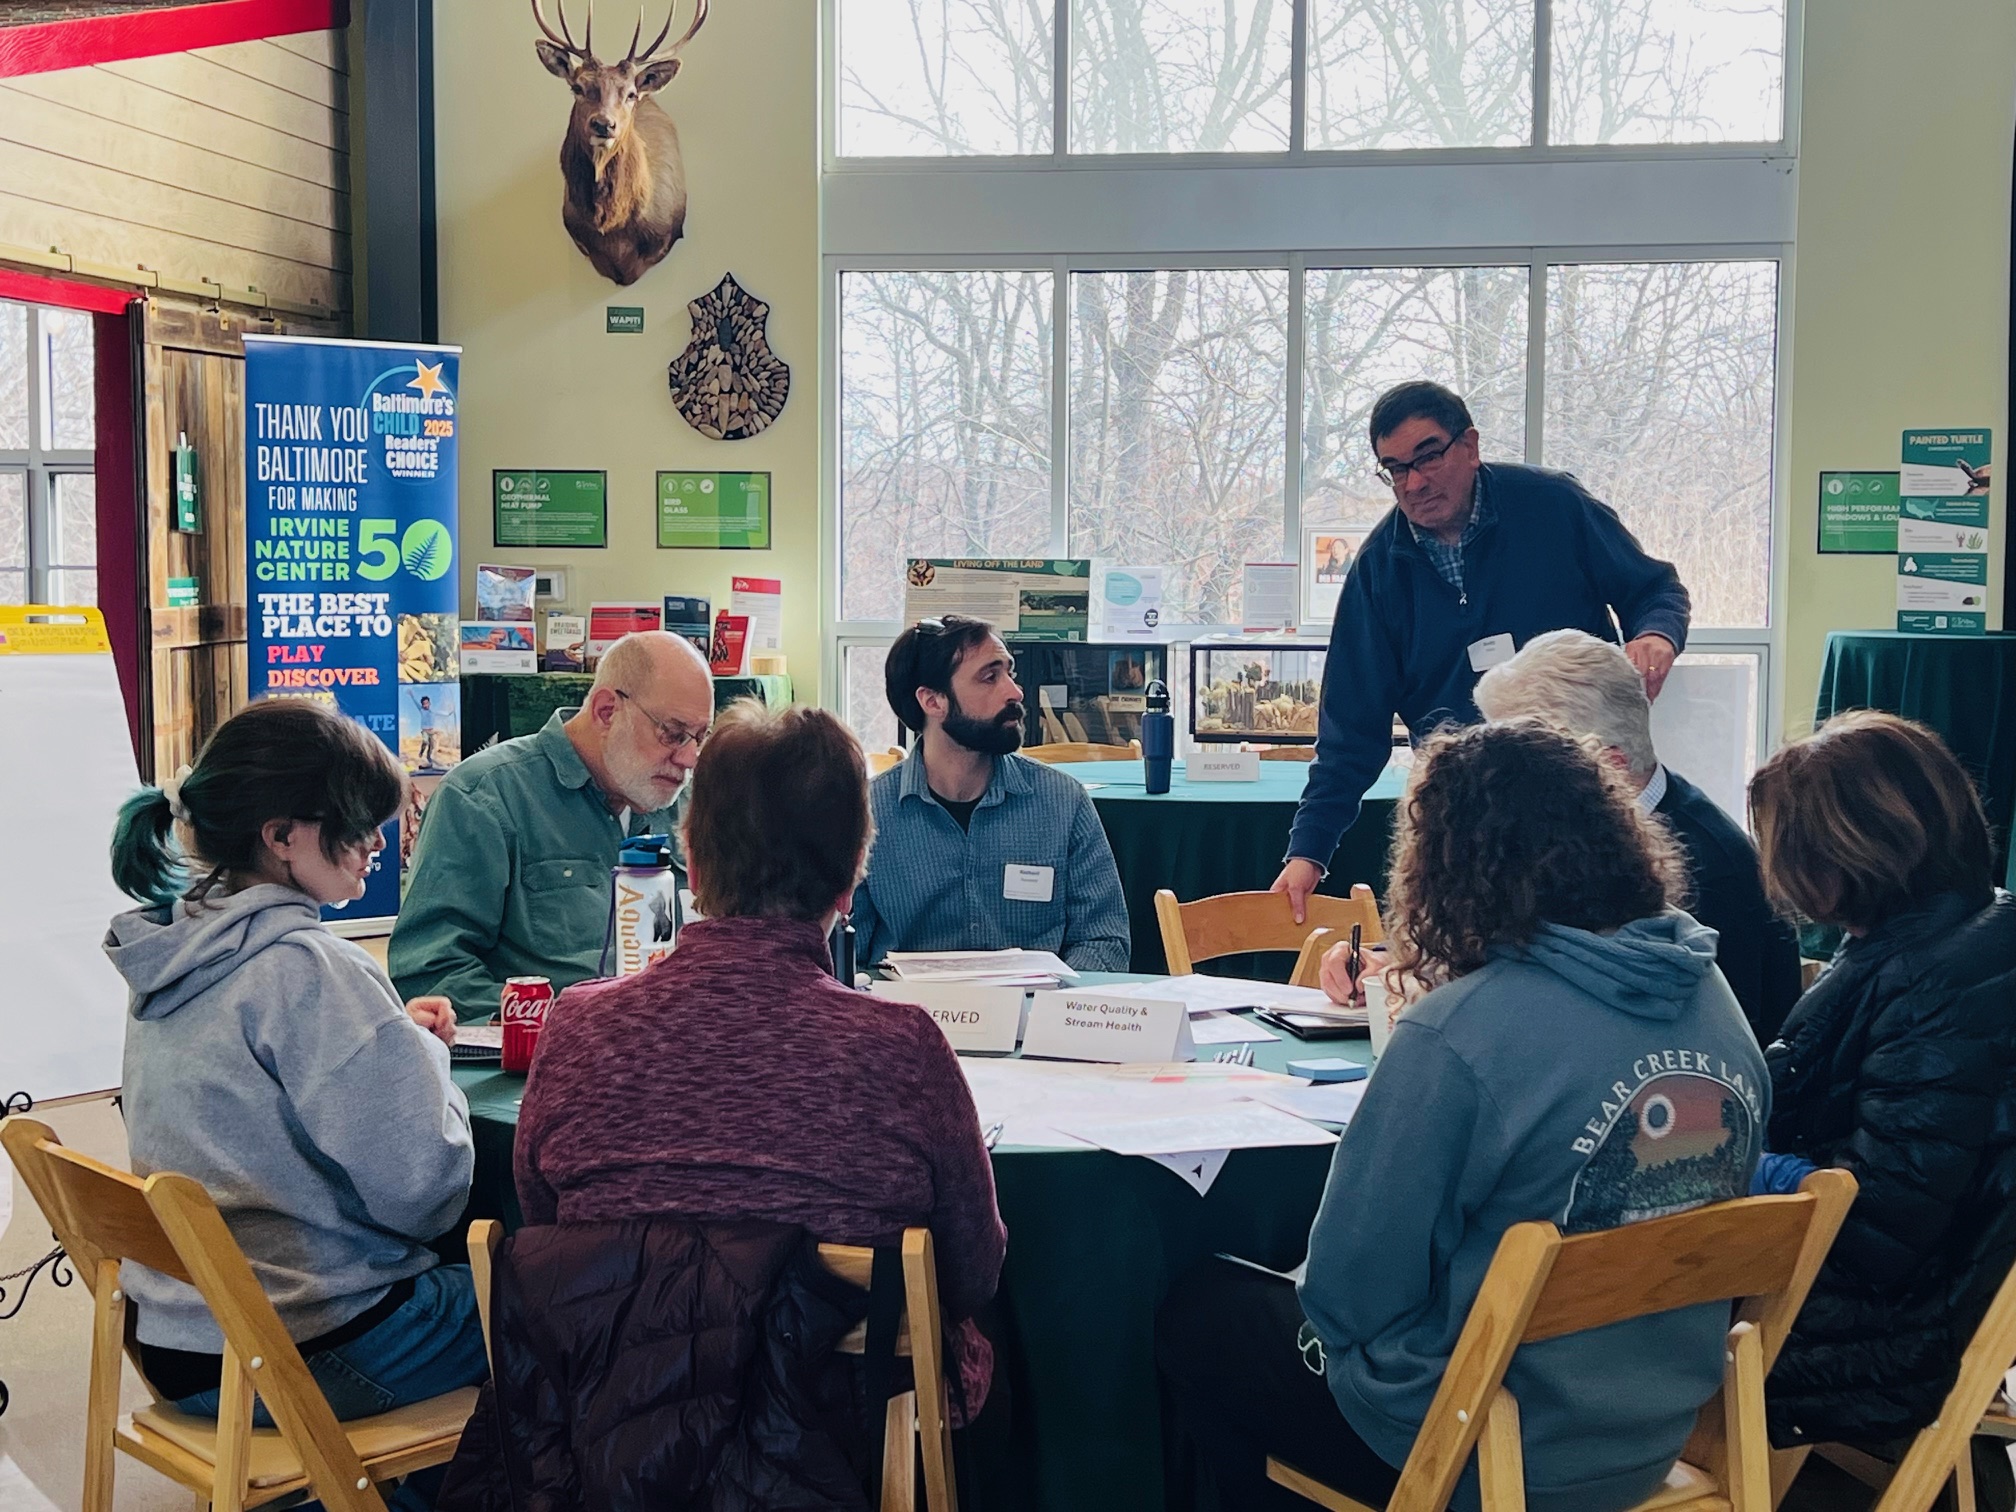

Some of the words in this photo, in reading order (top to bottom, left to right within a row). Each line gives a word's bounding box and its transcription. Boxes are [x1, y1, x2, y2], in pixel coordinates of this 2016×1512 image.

[610, 316, 640, 324] WAPITI
[373, 392, 454, 416] Baltimore's
[255, 403, 323, 441] THANK
[330, 406, 368, 443] YOU
[373, 411, 420, 435] CHILD
[424, 419, 453, 437] 2025
[385, 434, 440, 451] Readers'
[1909, 435, 1949, 445] PAINTED
[1950, 434, 1984, 444] TURTLE
[257, 446, 368, 484] BALTIMORE
[386, 451, 438, 470] CHOICE
[391, 469, 435, 478] WINNER
[268, 486, 296, 511] FOR
[301, 487, 357, 512] MAKING
[1827, 513, 1871, 521] WINDOWS
[270, 517, 350, 537] IRVINE
[255, 540, 350, 559] NATURE
[256, 562, 350, 581] CENTER
[953, 560, 982, 568] LIVING
[984, 560, 1000, 568] OFF
[1002, 560, 1018, 568] THE
[1020, 560, 1044, 568] LAND
[258, 593, 314, 616] THE
[319, 593, 389, 615] BEST
[261, 615, 351, 638] PLACE
[356, 615, 392, 637] TO
[267, 645, 326, 664] PLAY
[267, 667, 379, 687] DISCOVER
[930, 1010, 980, 1024] ERVED
[1066, 1001, 1098, 1012] Water
[1100, 1003, 1138, 1017] Quality
[1140, 1006, 1148, 1016] &
[1065, 1017, 1103, 1028] Stream
[1105, 1020, 1142, 1032] Health
[1571, 1080, 1632, 1155] BEAR
[1633, 1050, 1712, 1080] CREEK
